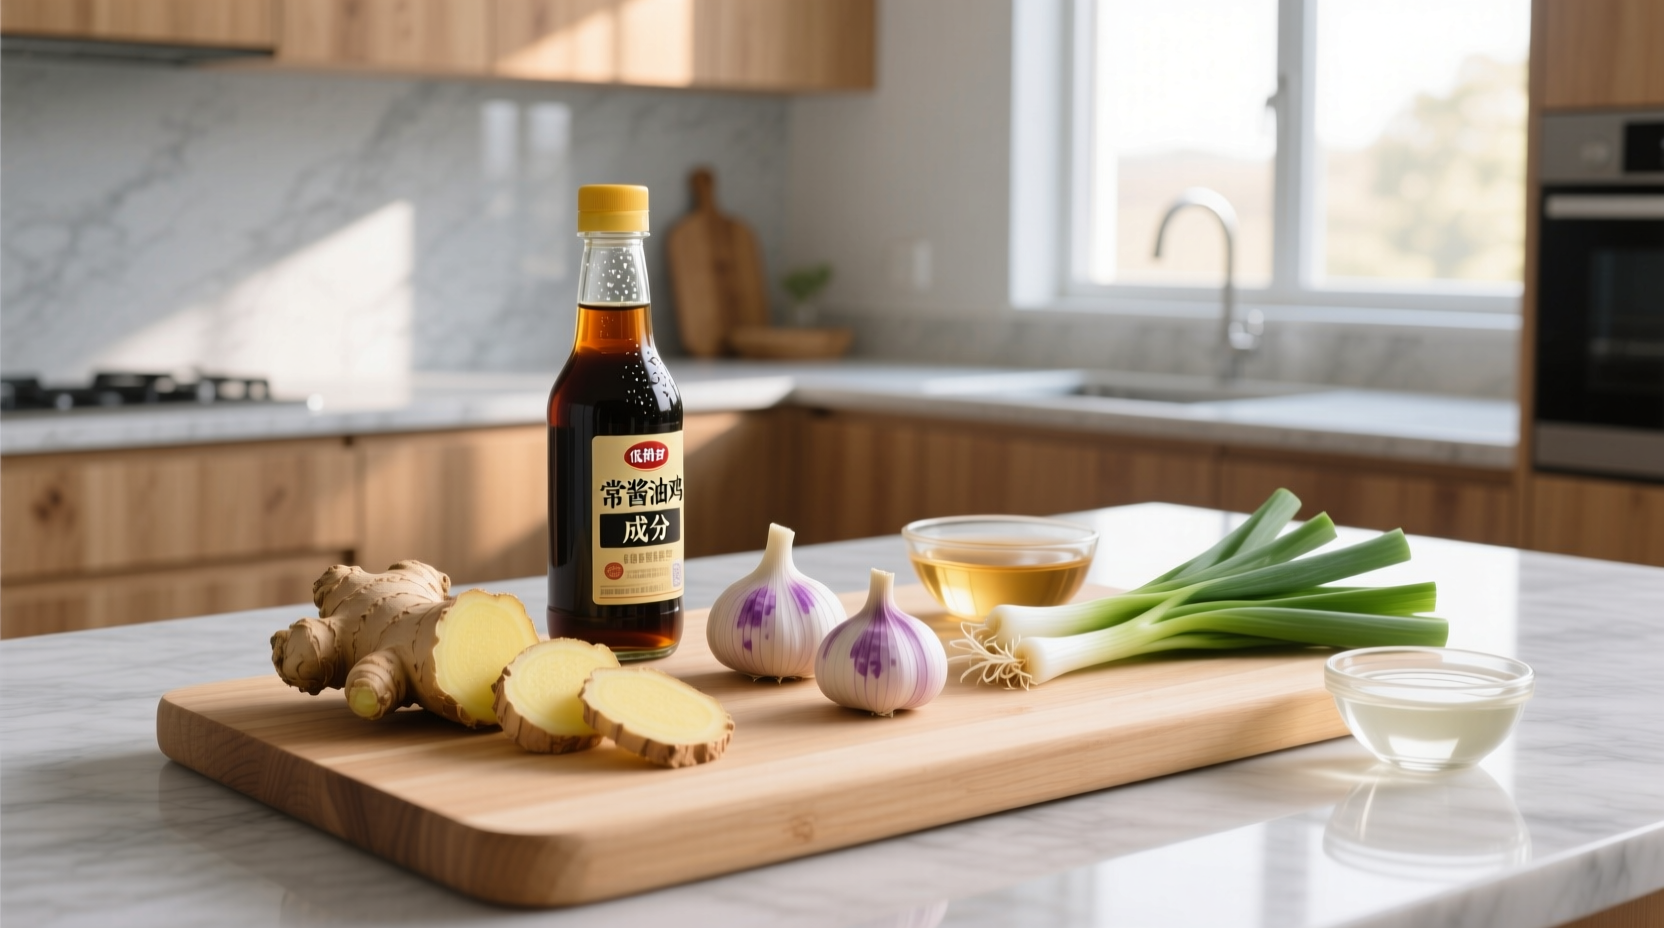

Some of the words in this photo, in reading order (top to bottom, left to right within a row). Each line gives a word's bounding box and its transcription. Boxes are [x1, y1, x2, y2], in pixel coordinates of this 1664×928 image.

[600, 475, 683, 509] 常酱油鸡
[622, 514, 670, 544] 成分
